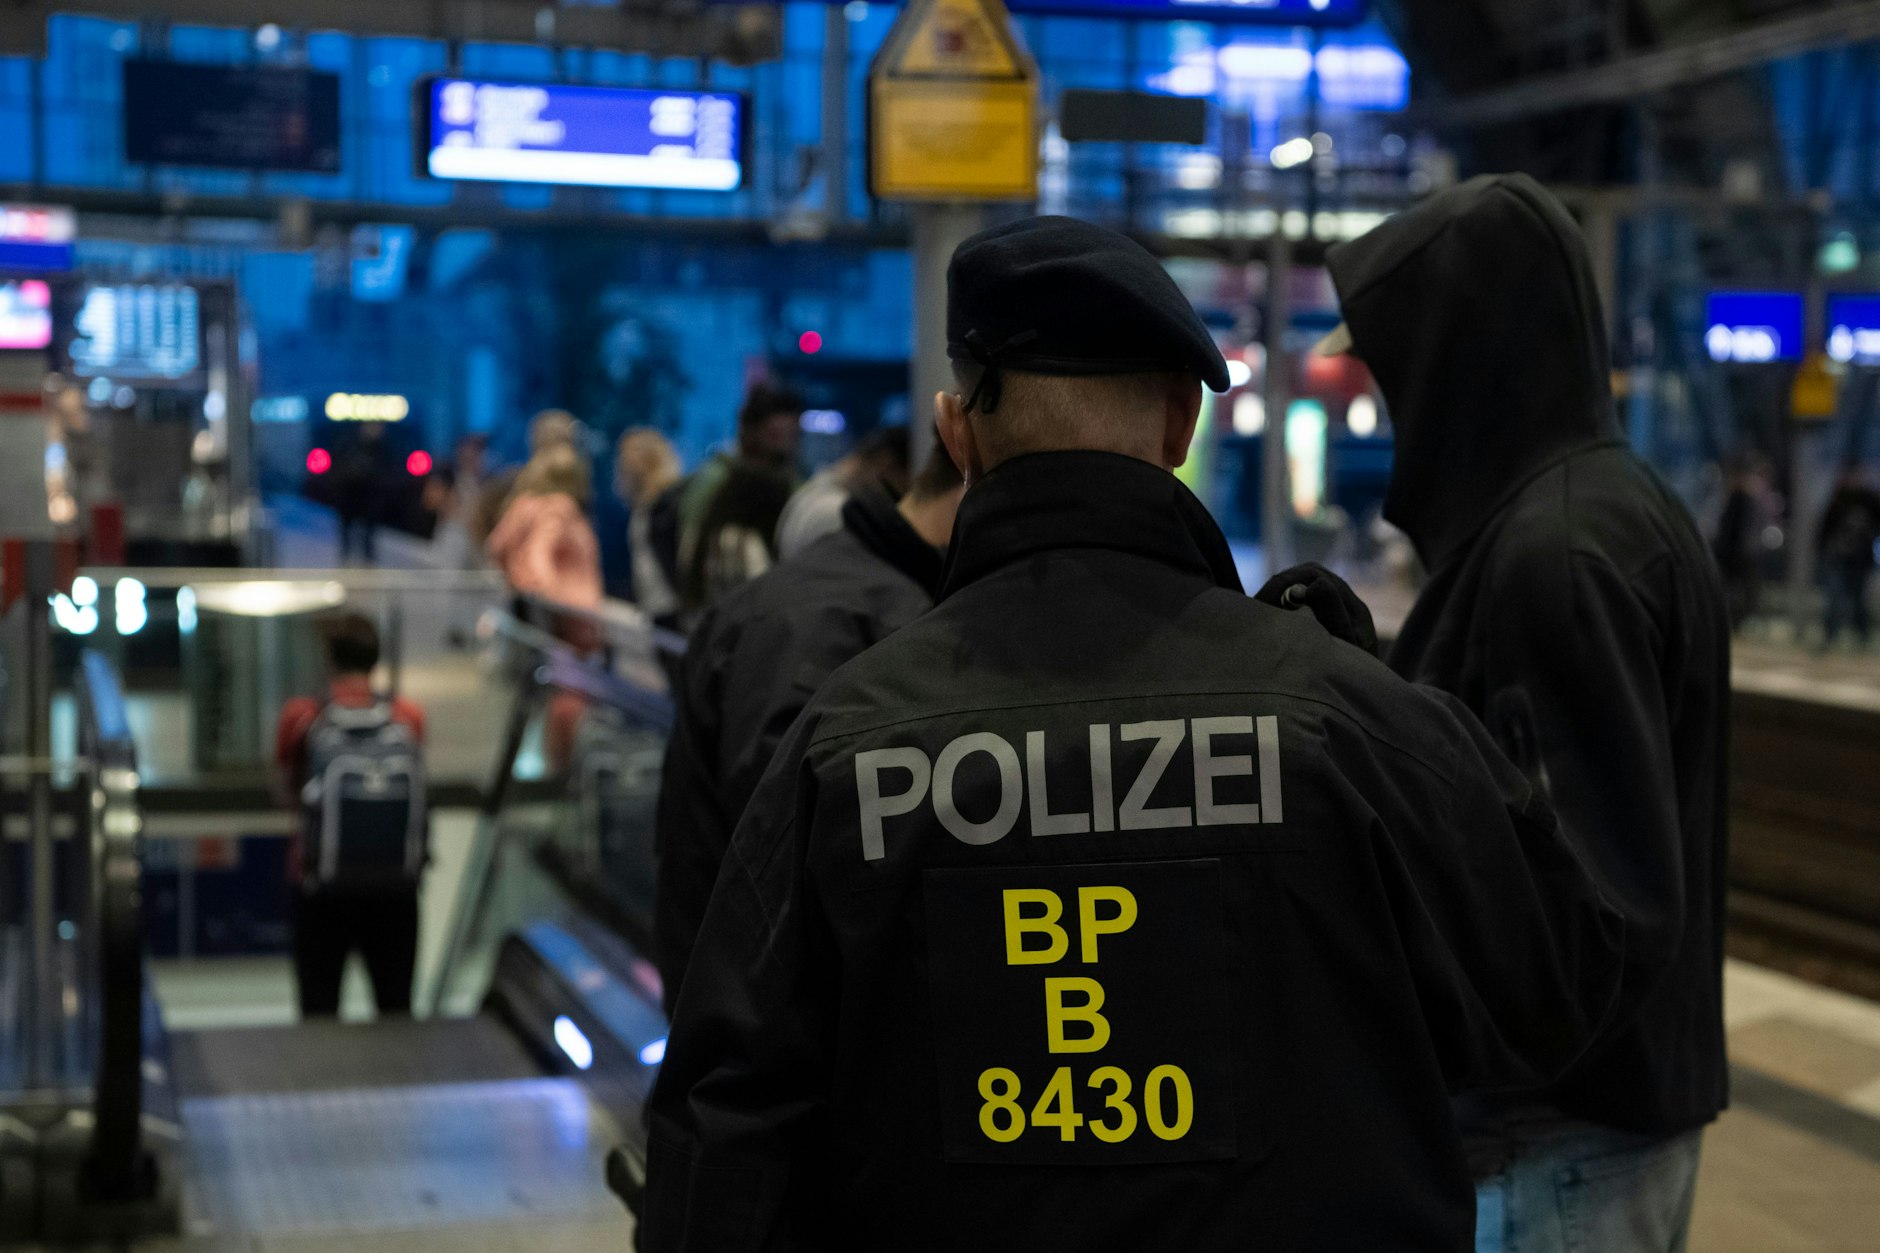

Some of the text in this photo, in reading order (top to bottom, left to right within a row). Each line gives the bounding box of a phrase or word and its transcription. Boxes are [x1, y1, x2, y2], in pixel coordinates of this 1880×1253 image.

[855, 715, 1283, 861] POLIZEI
[1002, 886, 1138, 965] BP
[1044, 977, 1111, 1054] B
[977, 1064, 1194, 1143] 8430
